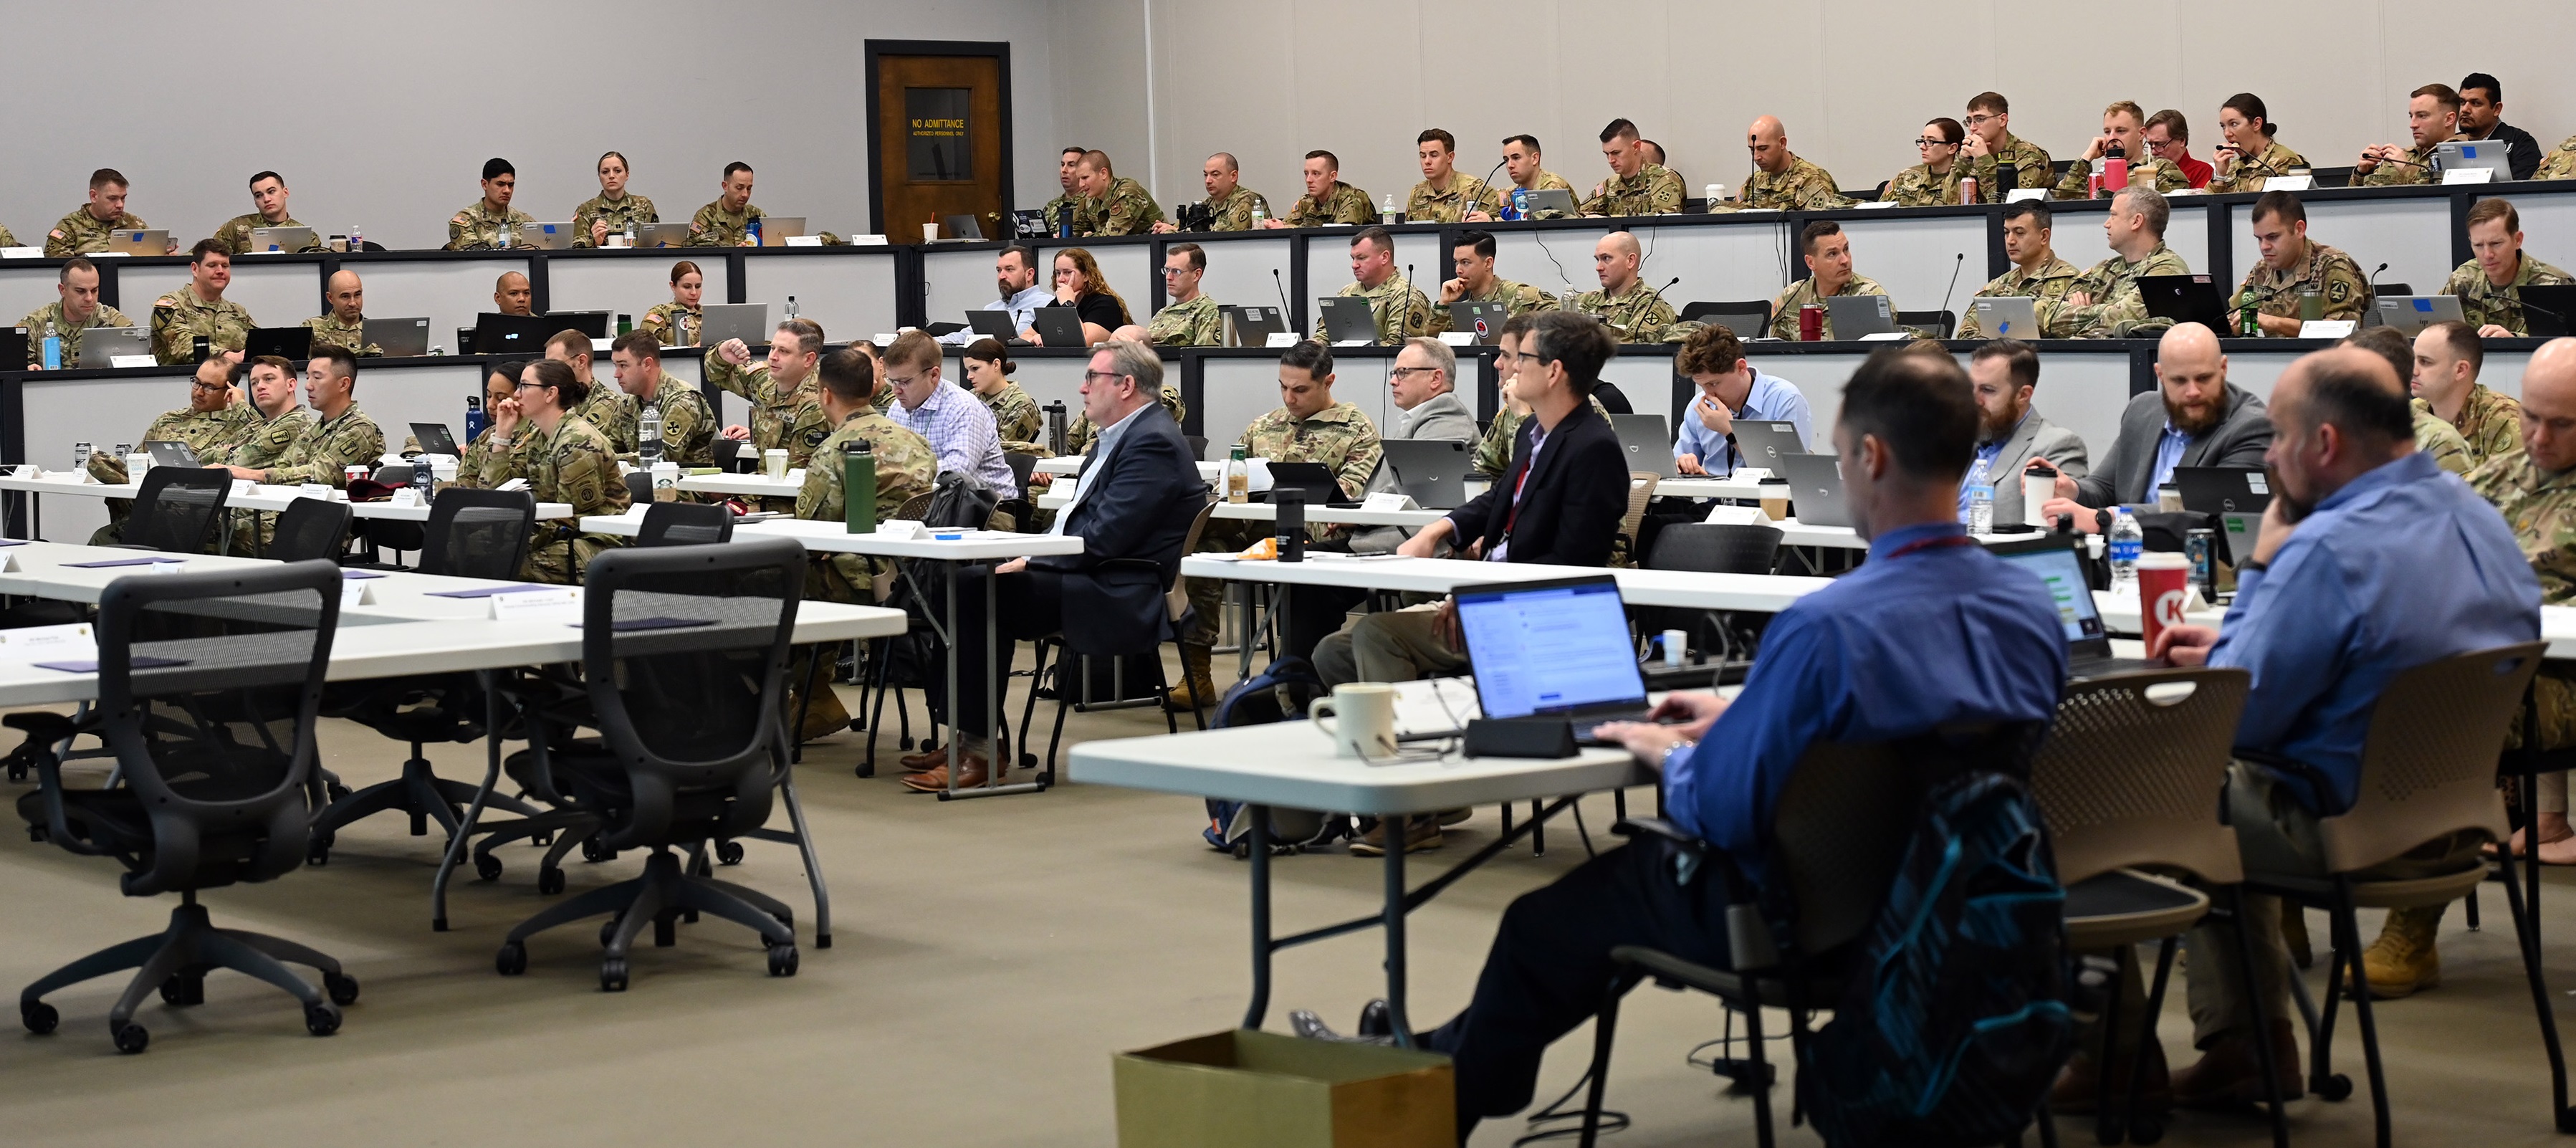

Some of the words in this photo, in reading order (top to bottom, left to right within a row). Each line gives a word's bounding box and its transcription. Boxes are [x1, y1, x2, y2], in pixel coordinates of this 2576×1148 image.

[912, 119, 922, 128] NO
[924, 119, 964, 128] ADMITTANCE
[2167, 599, 2185, 623] K
